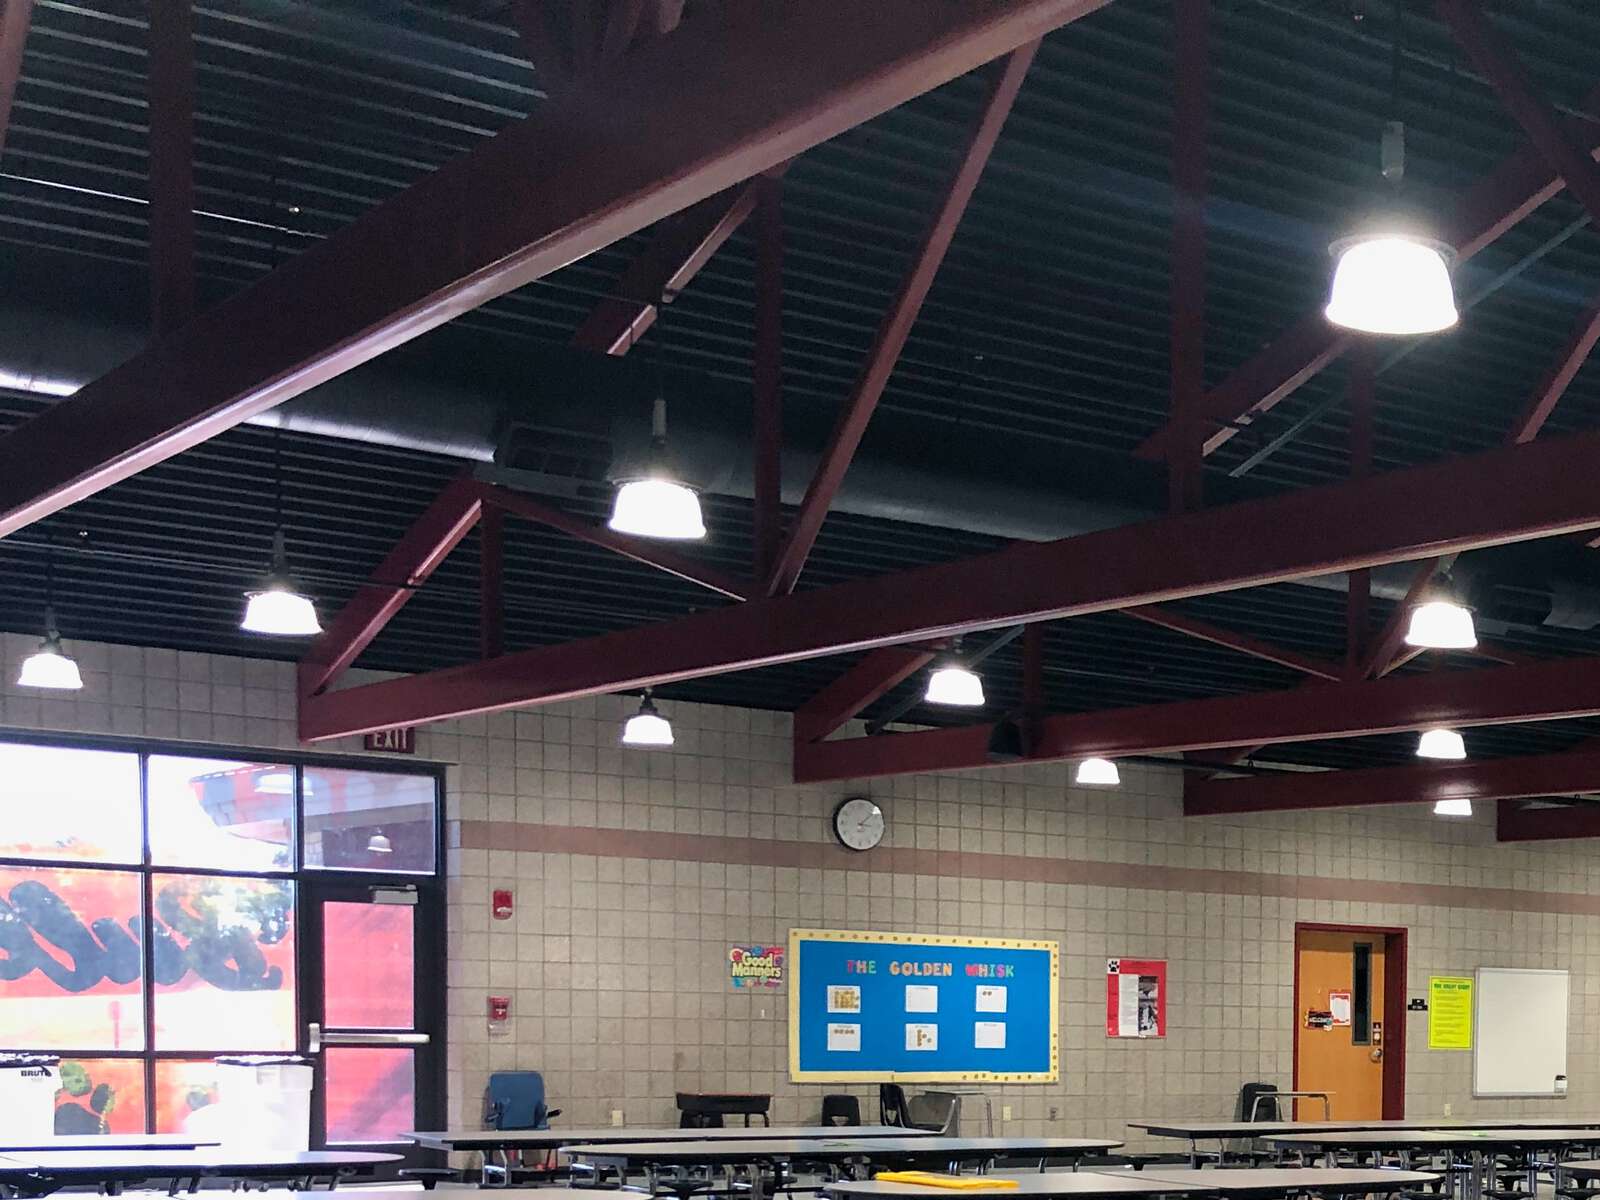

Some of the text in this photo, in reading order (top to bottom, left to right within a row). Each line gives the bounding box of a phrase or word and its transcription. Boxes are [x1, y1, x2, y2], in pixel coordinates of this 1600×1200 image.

[373, 728, 408, 749] EXIT
[742, 951, 773, 967] Good
[732, 962, 782, 978] Manners
[847, 960, 1014, 977] THE GOLDEN WHISK
